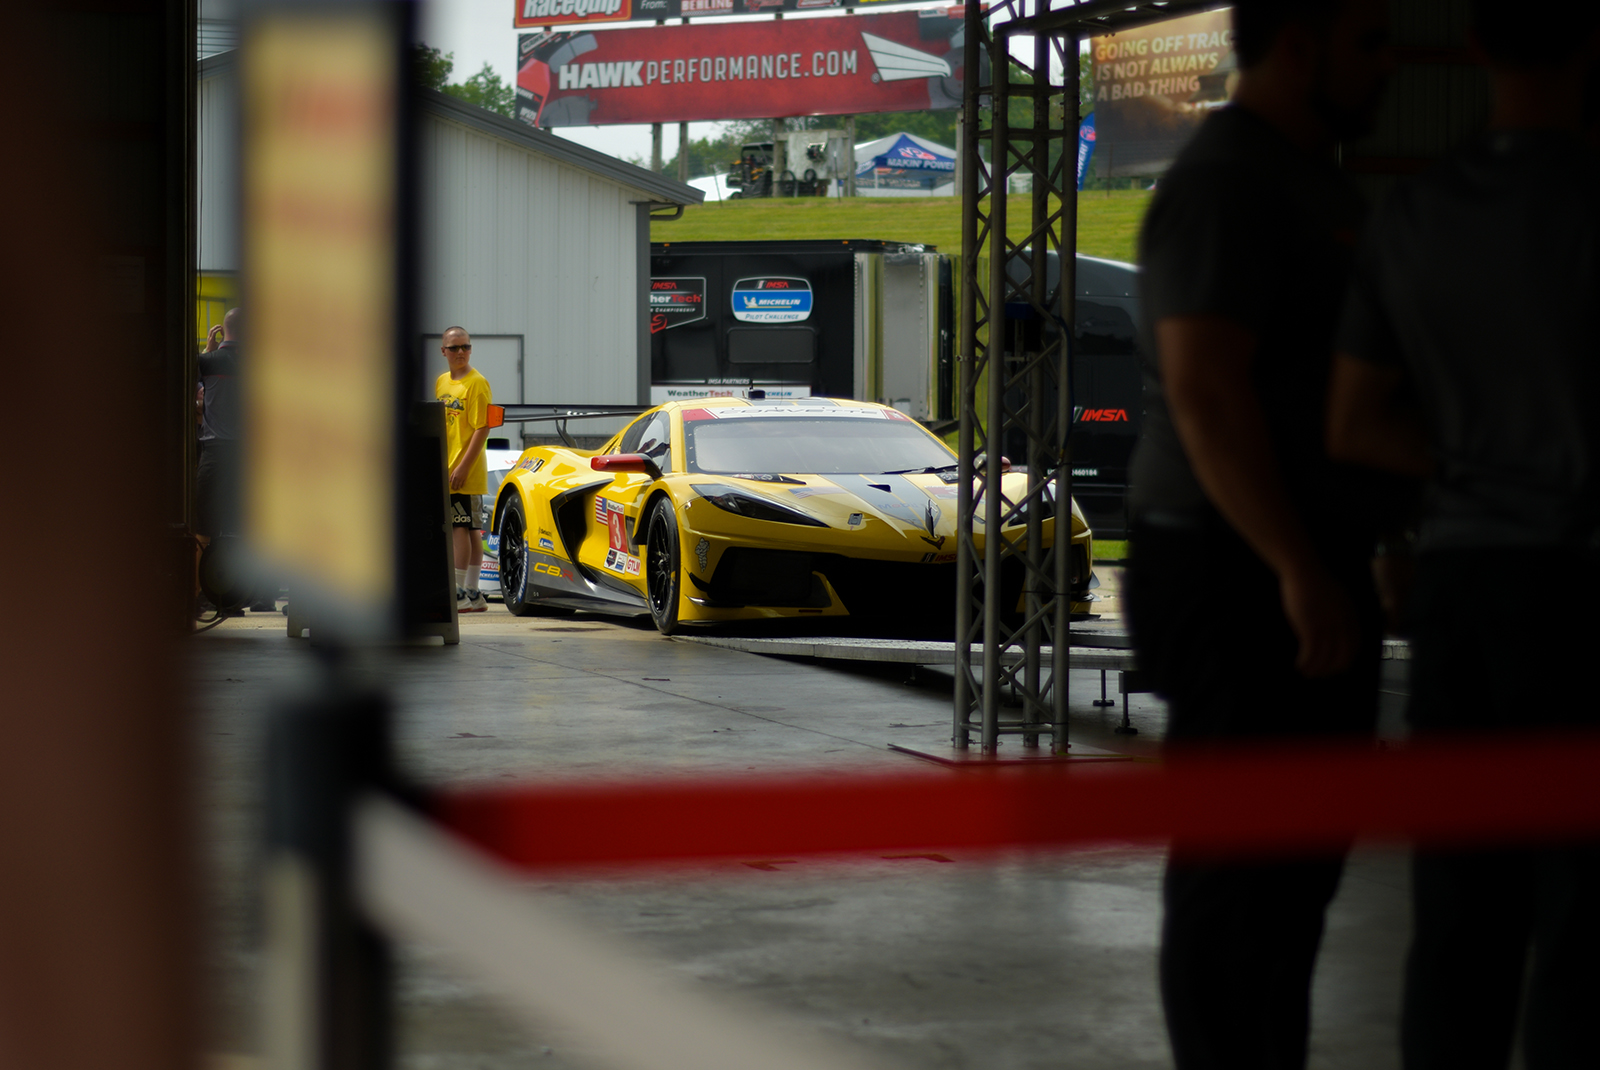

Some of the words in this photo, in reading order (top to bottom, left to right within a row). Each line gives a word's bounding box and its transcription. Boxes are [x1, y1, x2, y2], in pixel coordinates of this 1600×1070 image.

[523, 0, 623, 18] RaceQuip
[640, 0, 669, 10] From:
[1095, 38, 1149, 62] GOING
[1151, 33, 1185, 54] OFF
[1187, 29, 1231, 51] TRAC
[558, 50, 858, 90] HAWKPERFORMANCE.COM
[1096, 63, 1111, 82] IS
[1113, 59, 1149, 80] NOT
[1149, 52, 1219, 75] ALWAYS
[1097, 84, 1108, 102] A
[1111, 81, 1147, 101] BAD
[1148, 75, 1200, 96] THING
[887, 158, 923, 168] MAKIN'
[923, 159, 955, 171] POWE
[652, 282, 678, 290] IMSA
[765, 281, 789, 289] IMSA
[650, 294, 702, 304] herTech
[667, 389, 734, 398] WeatherTech
[1081, 408, 1128, 422] IMSA
[612, 512, 622, 550] 3
